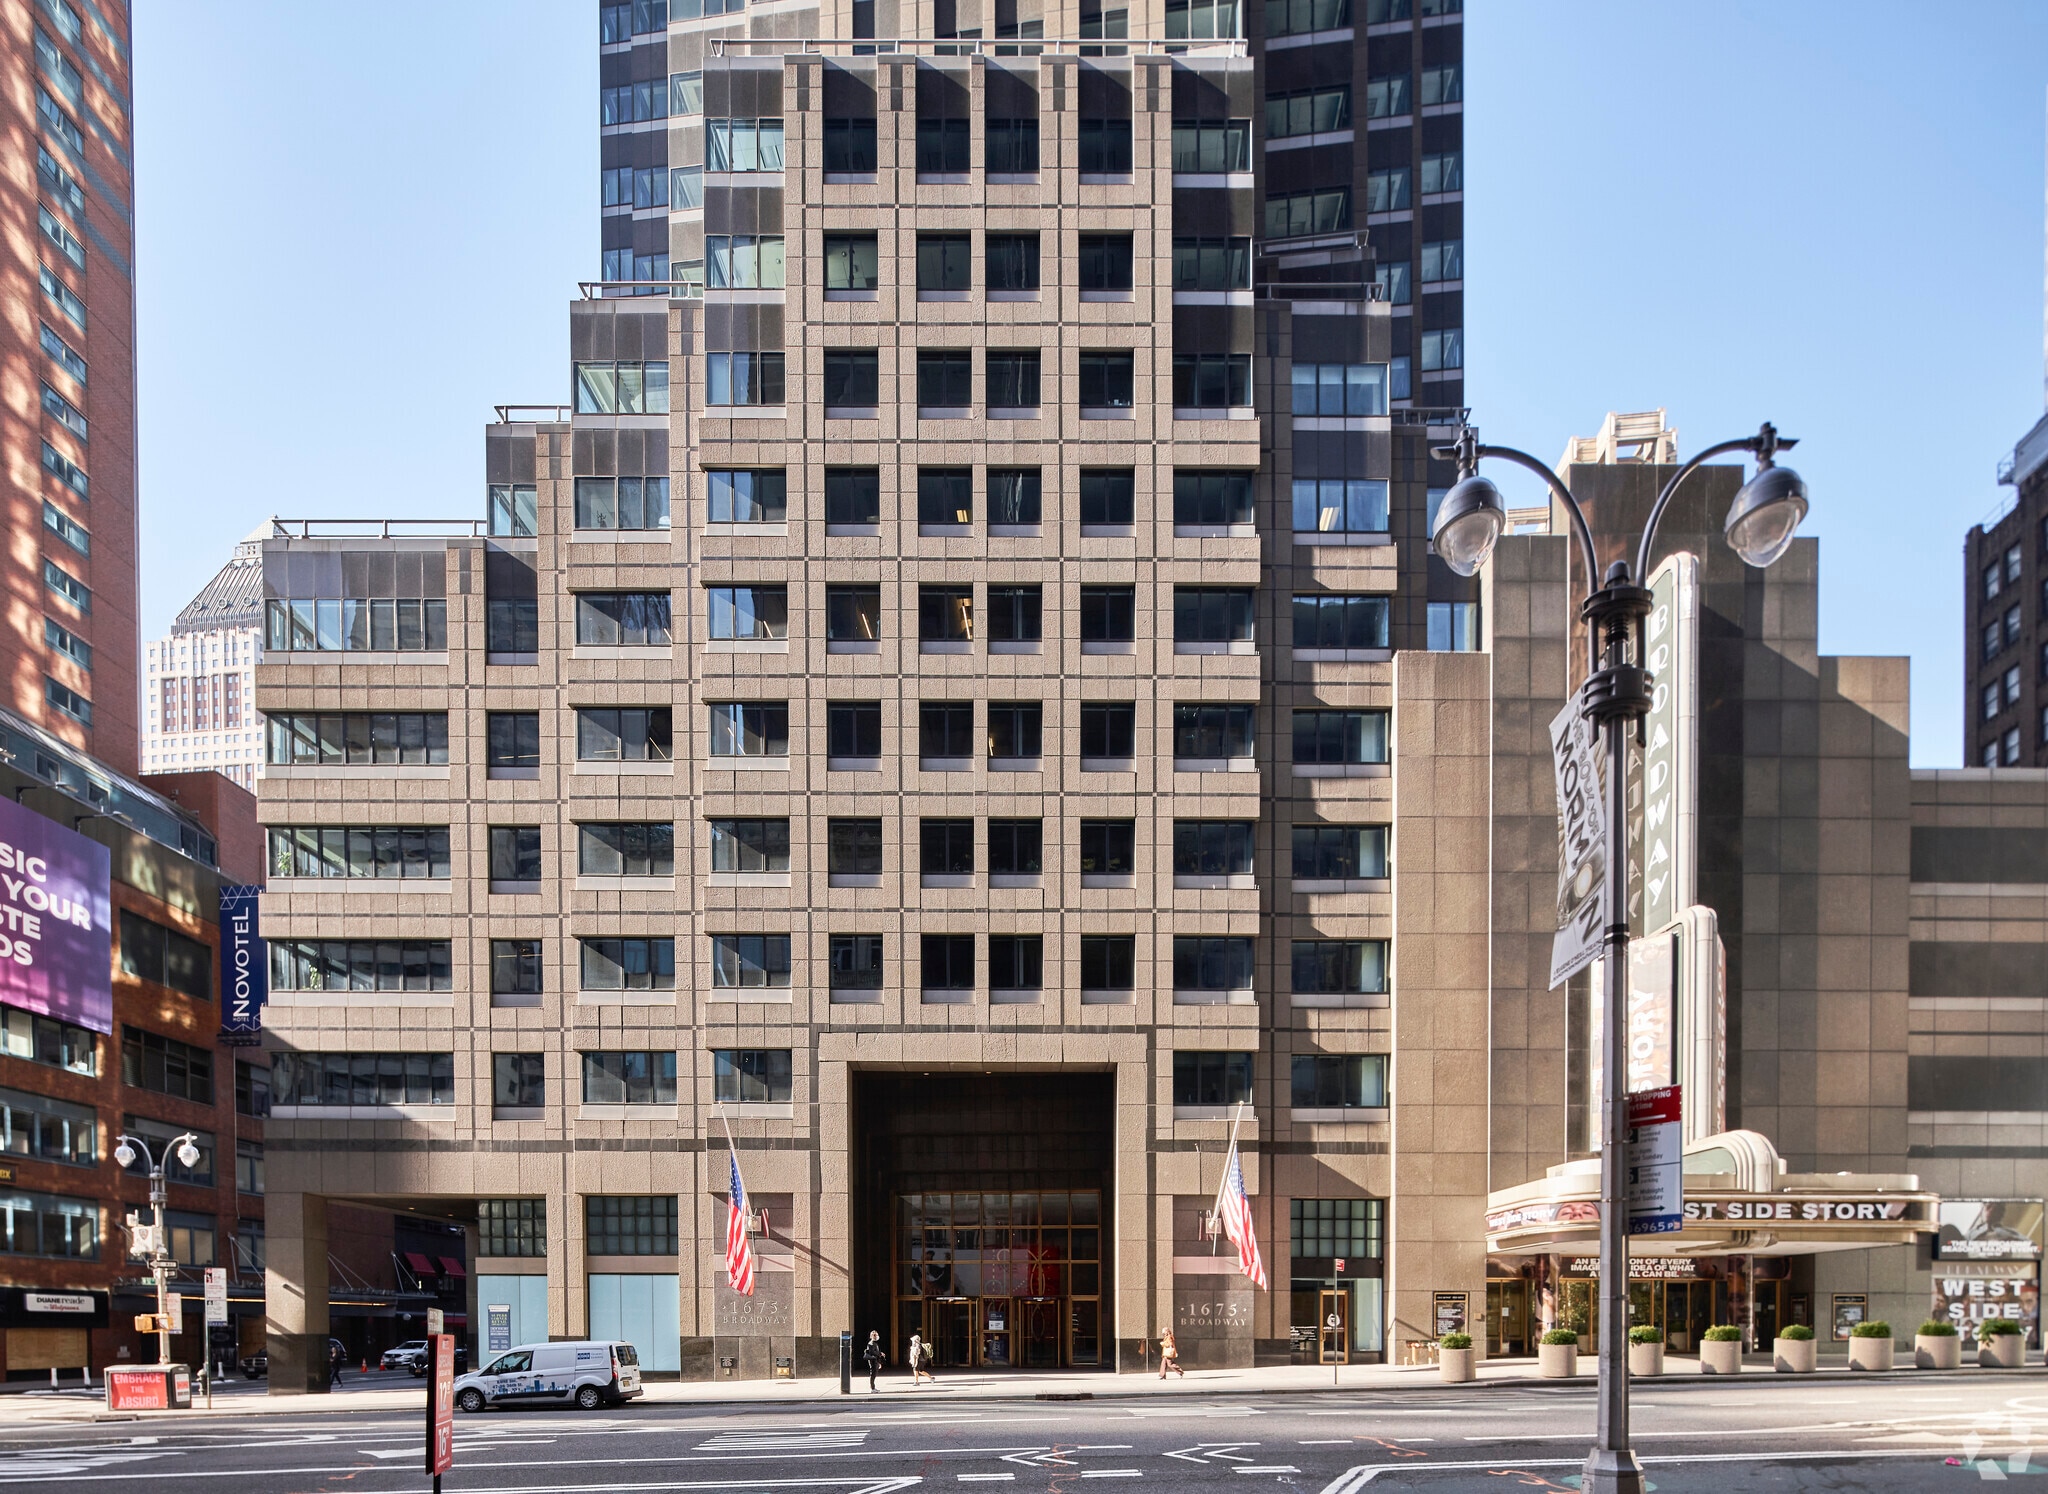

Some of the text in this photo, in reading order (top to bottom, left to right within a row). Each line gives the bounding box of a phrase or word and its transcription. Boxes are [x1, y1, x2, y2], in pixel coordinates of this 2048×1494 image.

[1648, 604, 1670, 906] BROADWAY
[1, 872, 92, 931] YOUR
[232, 906, 250, 1017] NOVOTEL
[1634, 1089, 1672, 1102] STOPPING
[1522, 1209, 1555, 1221] STORY
[1727, 1202, 1792, 1219] SIDE
[1802, 1202, 1893, 1219] STORY
[1942, 1279, 2026, 1296] WEST
[730, 1301, 778, 1314] 1675
[1190, 1303, 1237, 1316] 1675
[1948, 1302, 2020, 1319] SIDE
[1180, 1318, 1246, 1326] BROADWAY
[114, 1373, 161, 1384] EMBRACE
[118, 1396, 159, 1408] ABSURD
